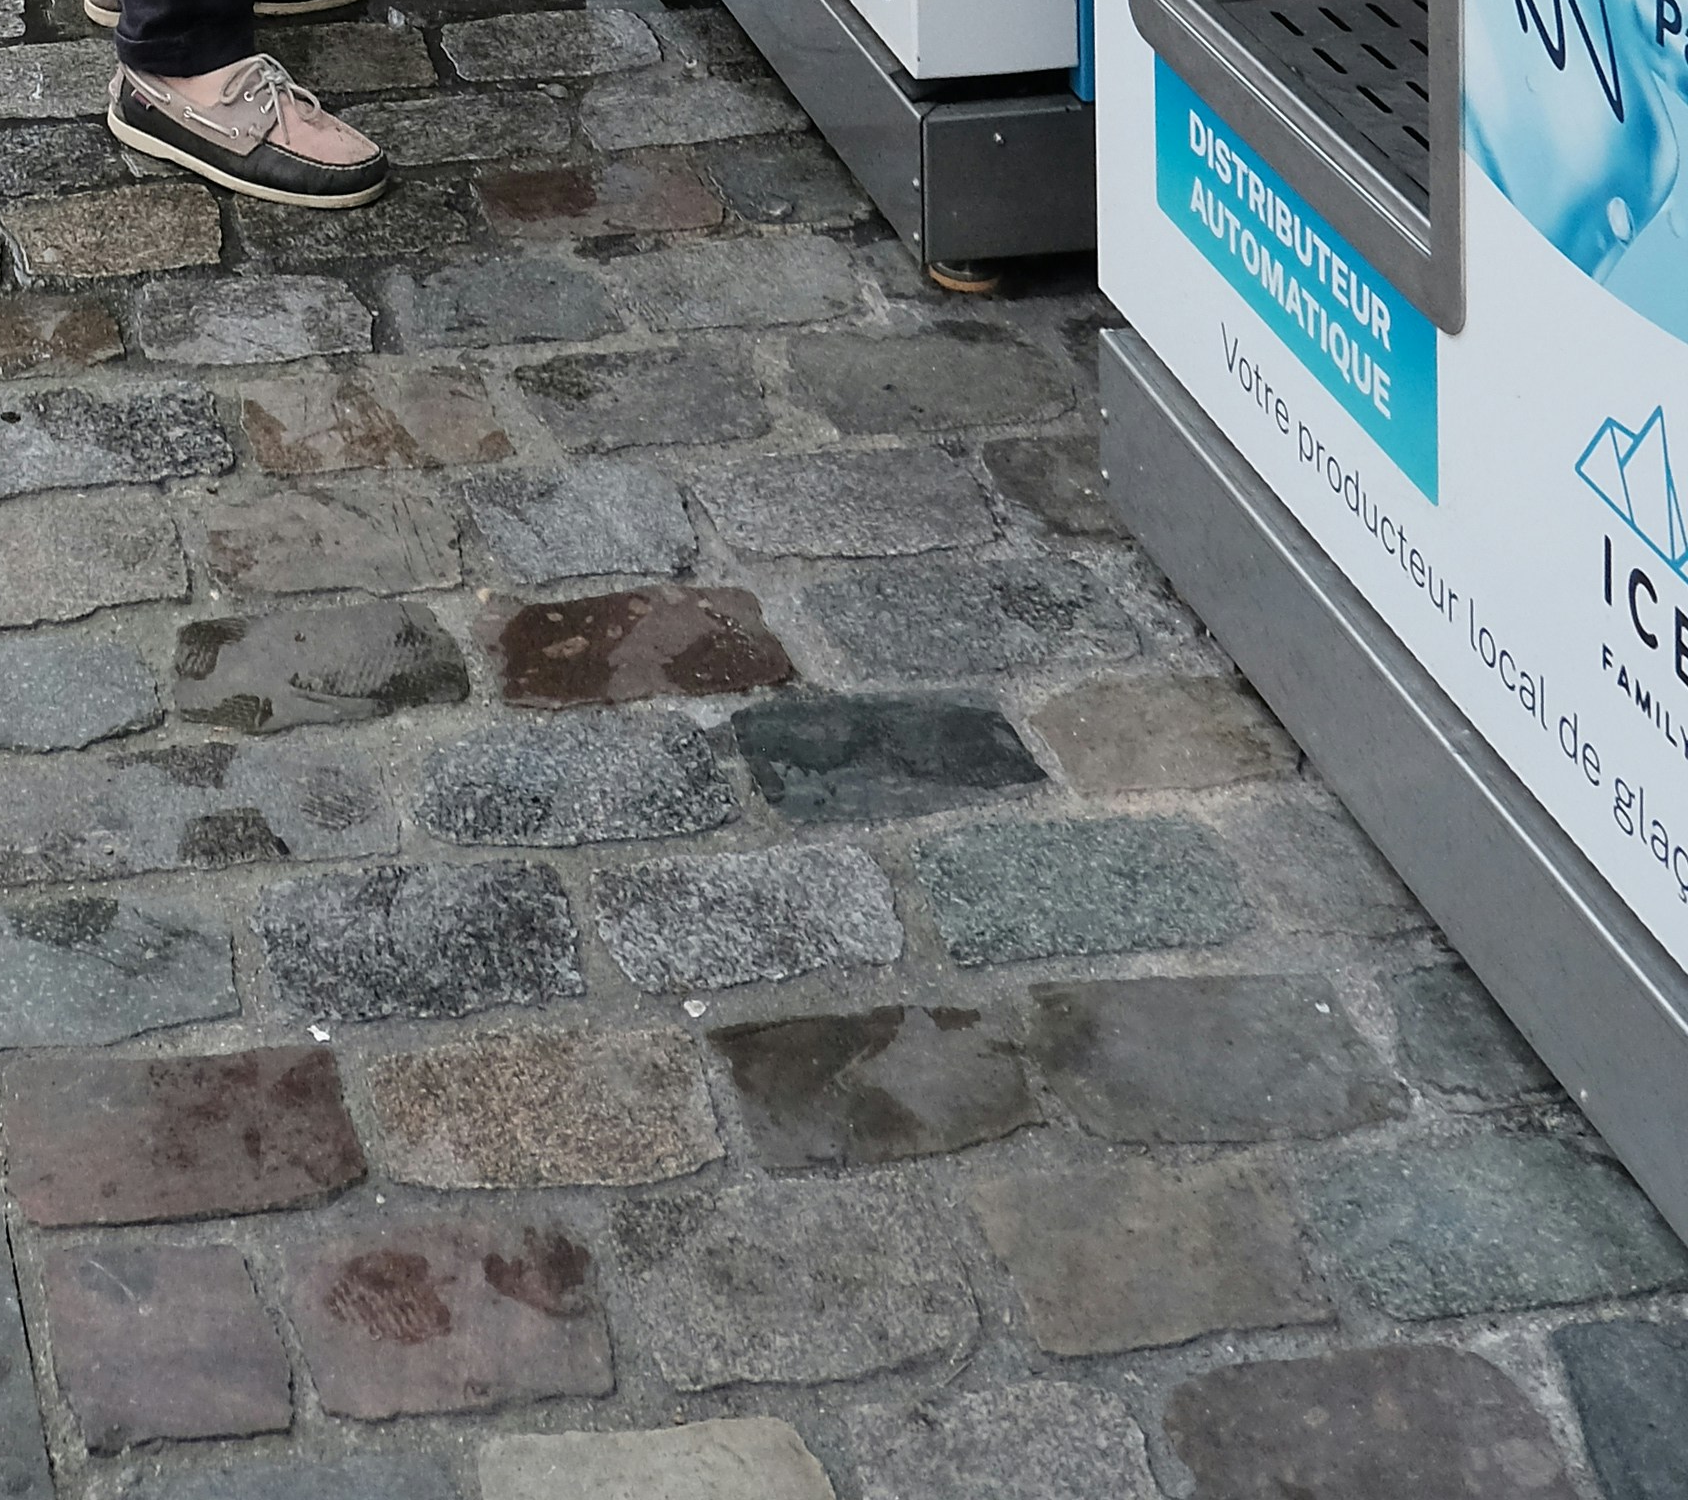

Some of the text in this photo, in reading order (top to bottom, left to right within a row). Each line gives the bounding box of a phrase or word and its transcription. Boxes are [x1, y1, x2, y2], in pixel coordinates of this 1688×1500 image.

[1189, 109, 1391, 352] DISTRIBUTEUR
[1190, 176, 1391, 420] AUTOMATIQUE
[1220, 321, 1291, 434] Votre
[1298, 420, 1459, 622] producteur
[1470, 598, 1548, 731] local
[1559, 713, 1600, 787] de
